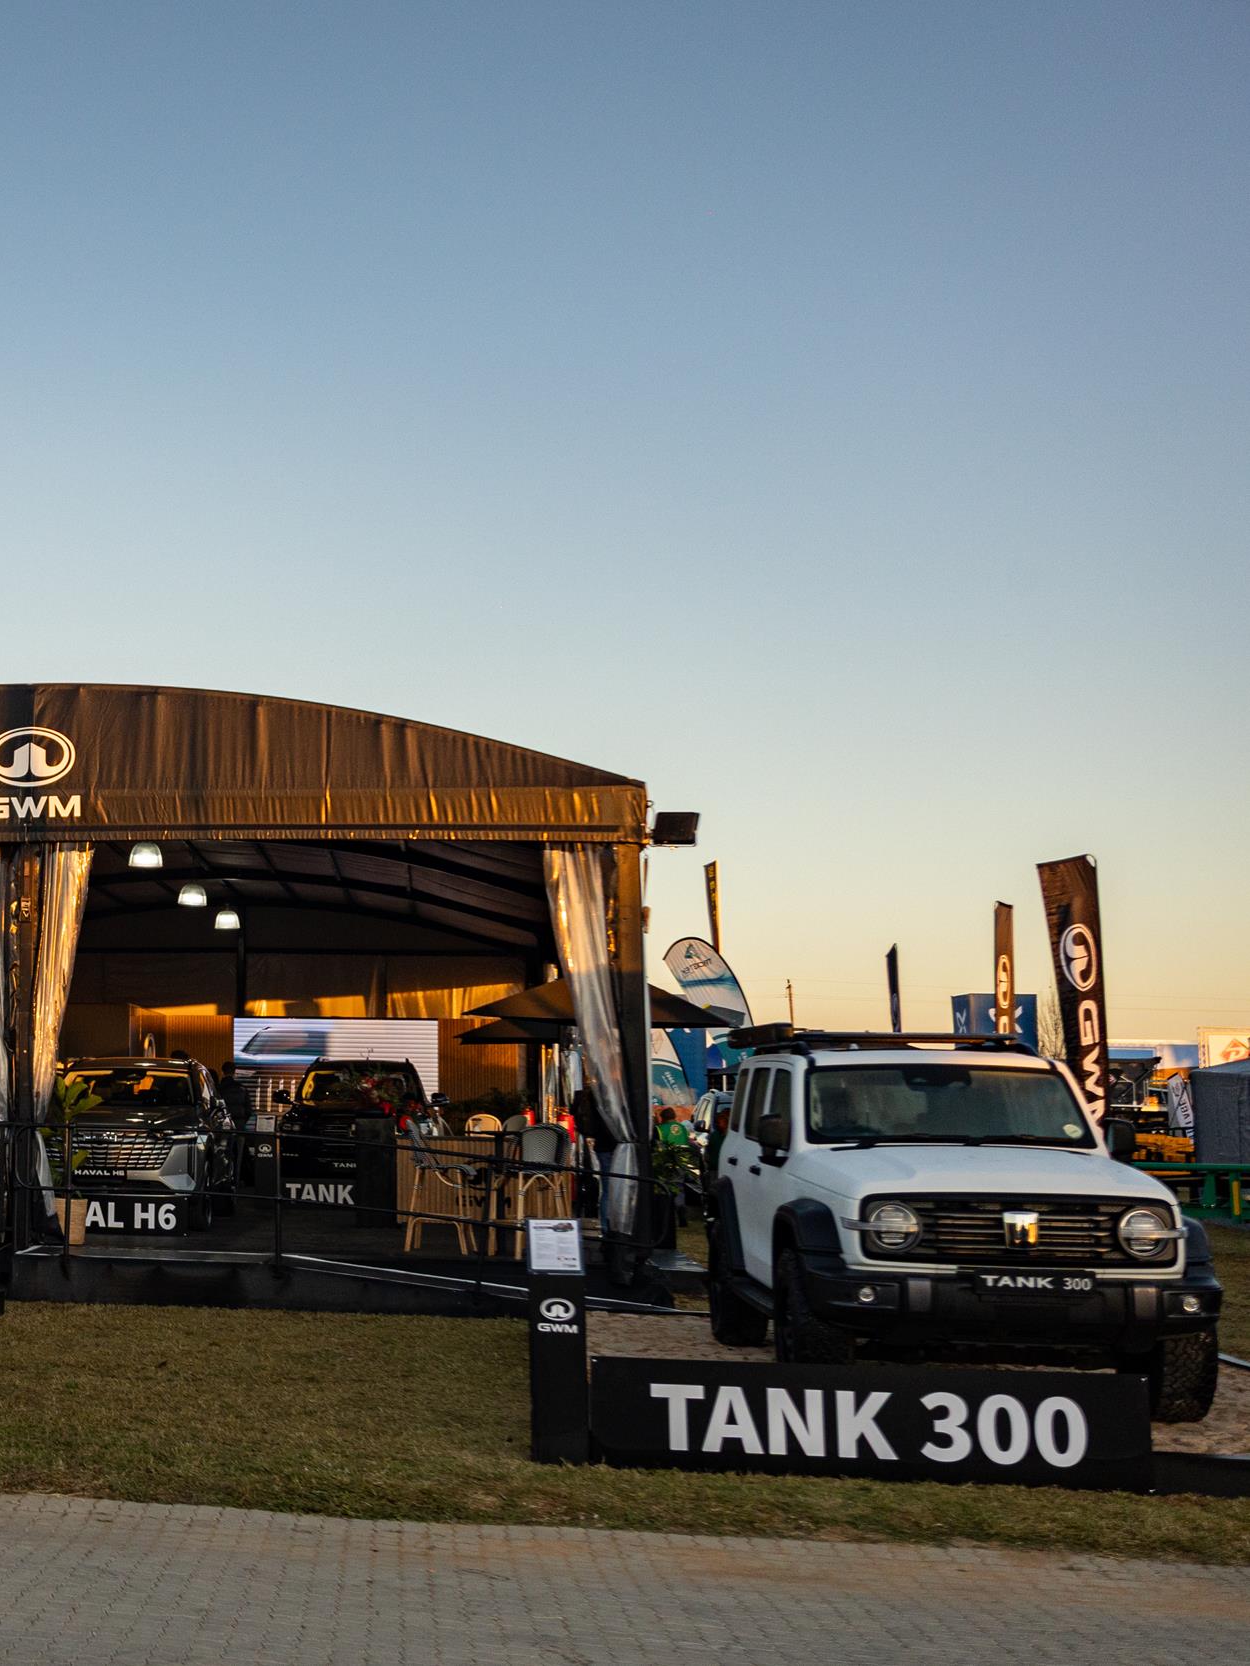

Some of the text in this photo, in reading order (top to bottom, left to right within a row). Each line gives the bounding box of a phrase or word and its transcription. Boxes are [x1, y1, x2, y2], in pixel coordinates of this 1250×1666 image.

[286, 1183, 355, 1205] TANK
[85, 1201, 177, 1230] AL H6
[979, 1275, 1092, 1290] TANK 300
[537, 1322, 579, 1334] GWM
[650, 1383, 1088, 1468] TANK 300
